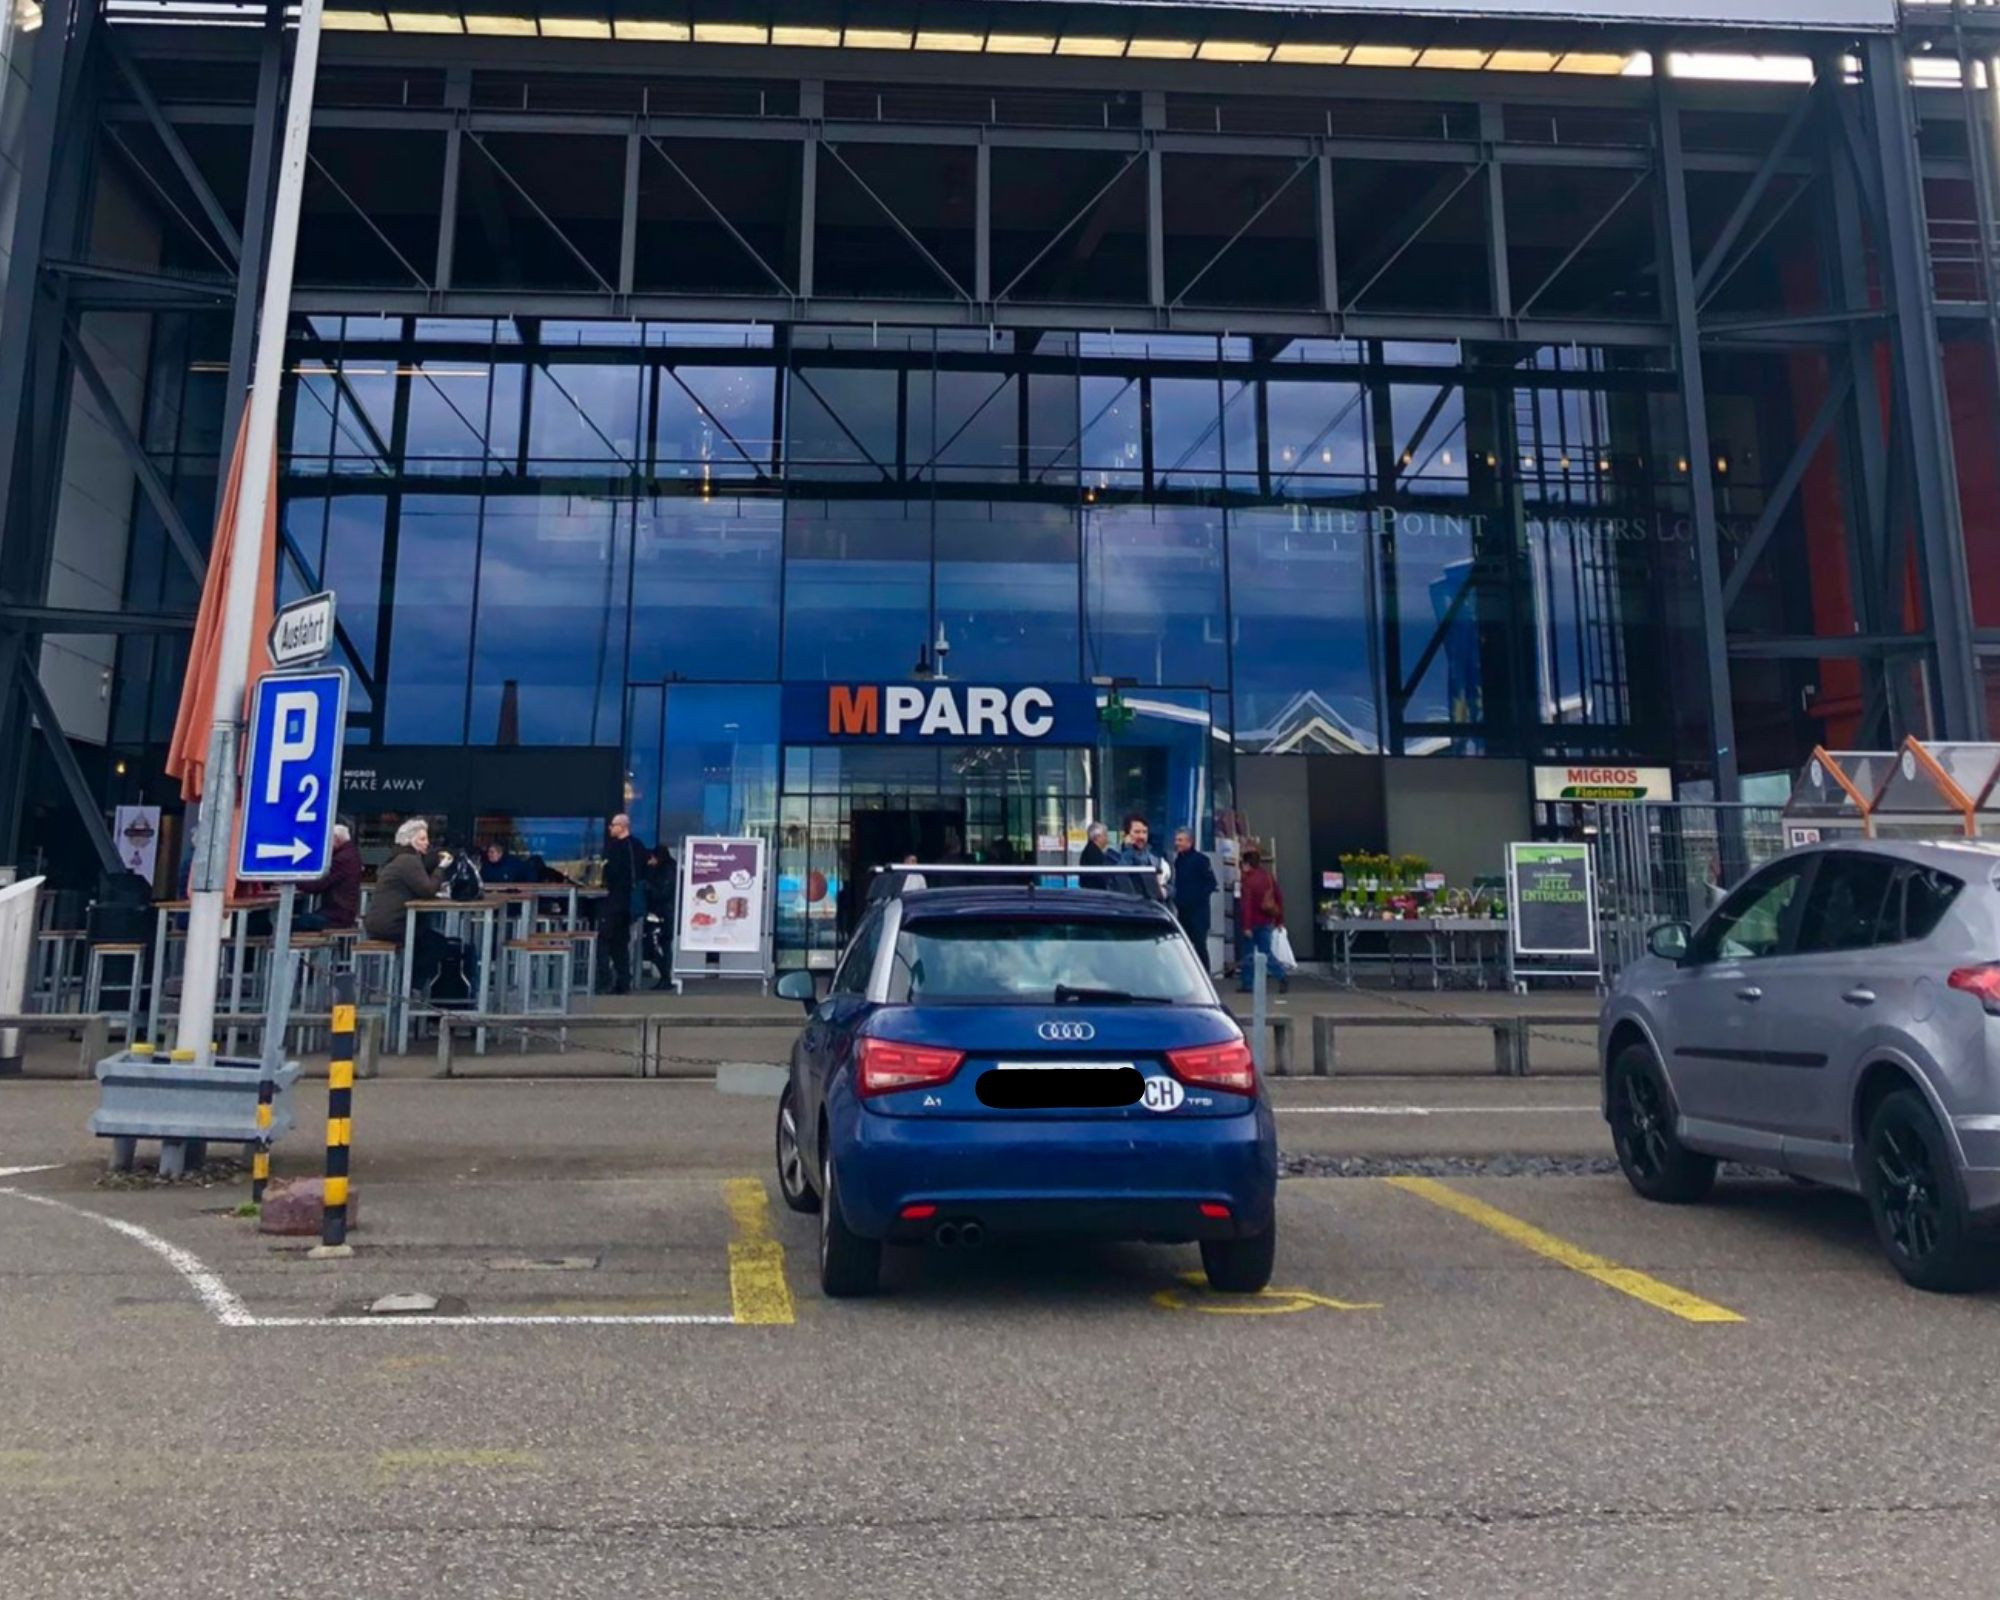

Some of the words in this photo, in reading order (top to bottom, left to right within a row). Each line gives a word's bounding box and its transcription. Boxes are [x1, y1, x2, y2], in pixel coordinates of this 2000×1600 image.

[1283, 503, 1358, 534] THE
[1372, 505, 1488, 537] POINT
[1657, 512, 1757, 544] LONG
[281, 611, 325, 651] Ausfahrt
[828, 685, 1054, 737] MPARC
[266, 691, 319, 804] P
[295, 774, 319, 822] 2
[344, 779, 377, 791] TAKE
[382, 779, 424, 791] AWAY
[1567, 769, 1638, 784] MIGROS
[923, 1095, 942, 1106] A1
[1145, 1081, 1175, 1107] CH
